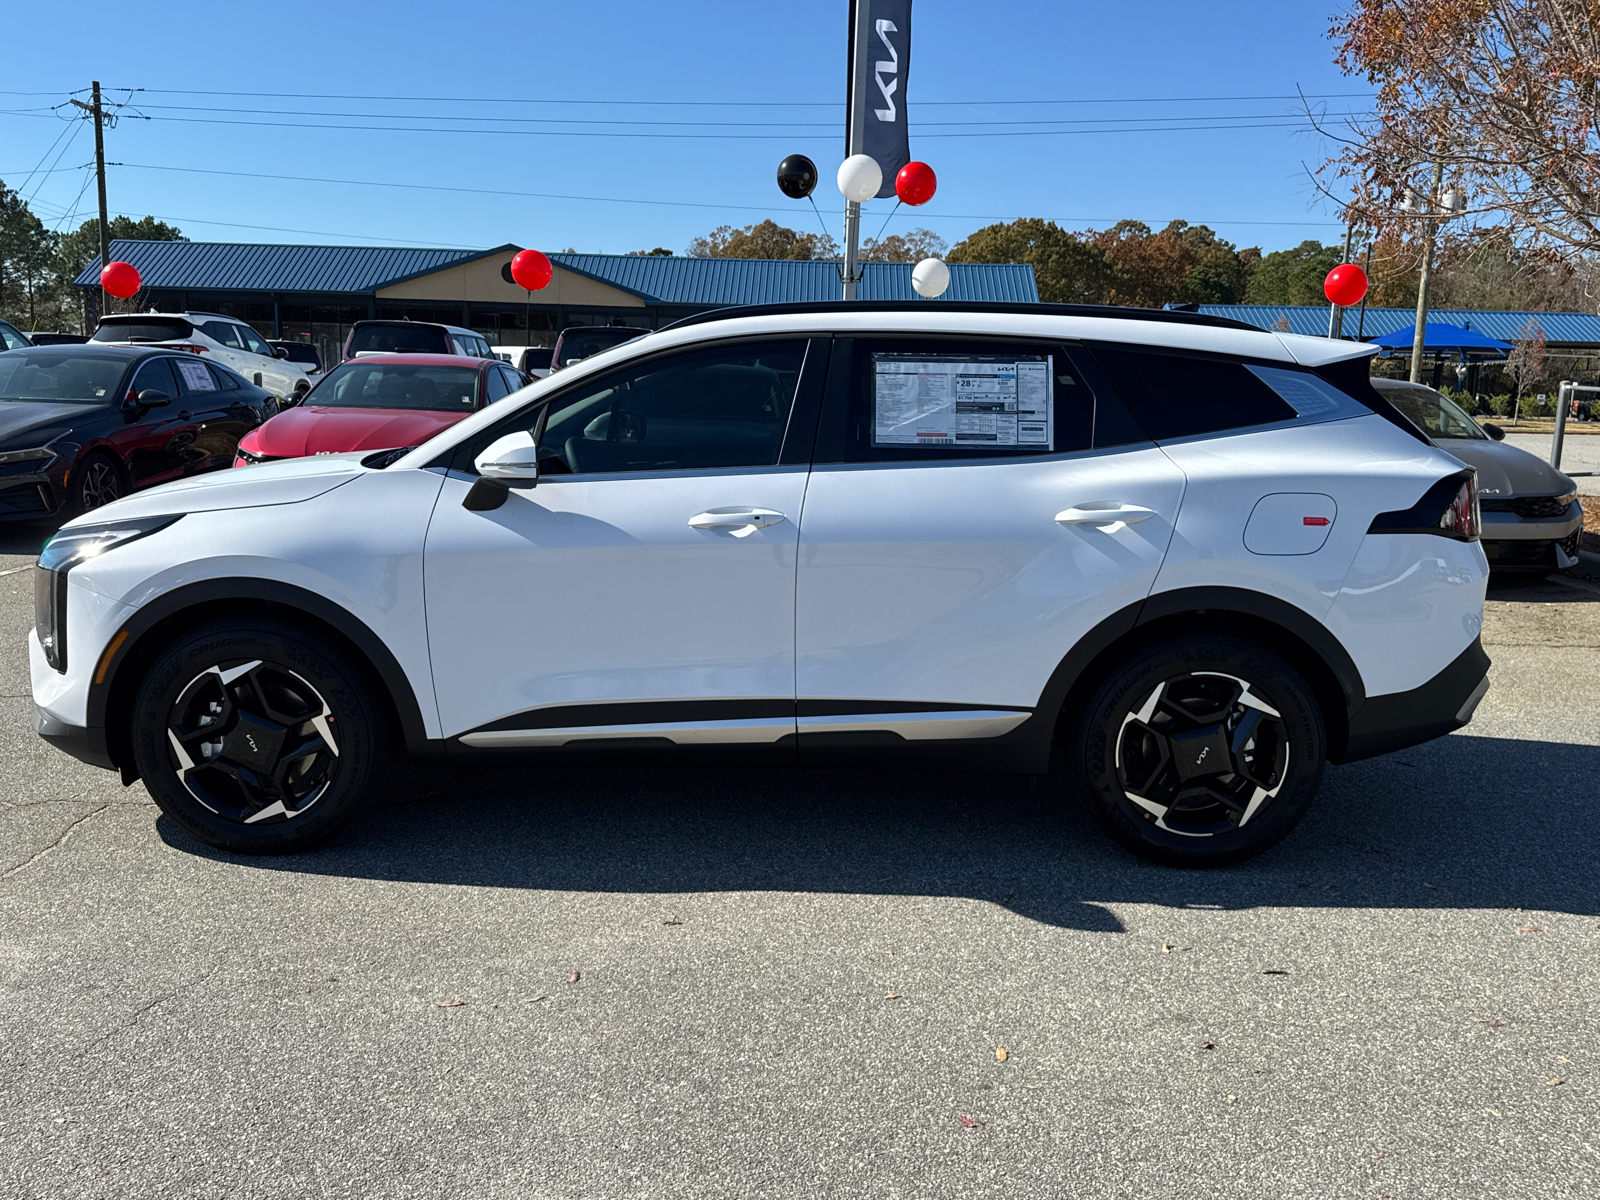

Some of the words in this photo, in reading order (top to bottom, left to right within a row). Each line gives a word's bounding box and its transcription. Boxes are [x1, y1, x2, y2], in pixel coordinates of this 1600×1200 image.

[874, 19, 898, 122] KIA
[189, 637, 257, 658] CRUGEN
[1103, 664, 1153, 721] CRUGEN
[1283, 685, 1305, 714] 235/60
[1302, 716, 1311, 735] R18
[352, 732, 364, 766] 235/60
[348, 768, 358, 788] R18
[163, 795, 217, 838] KUMHO
[335, 788, 351, 810] 103H
